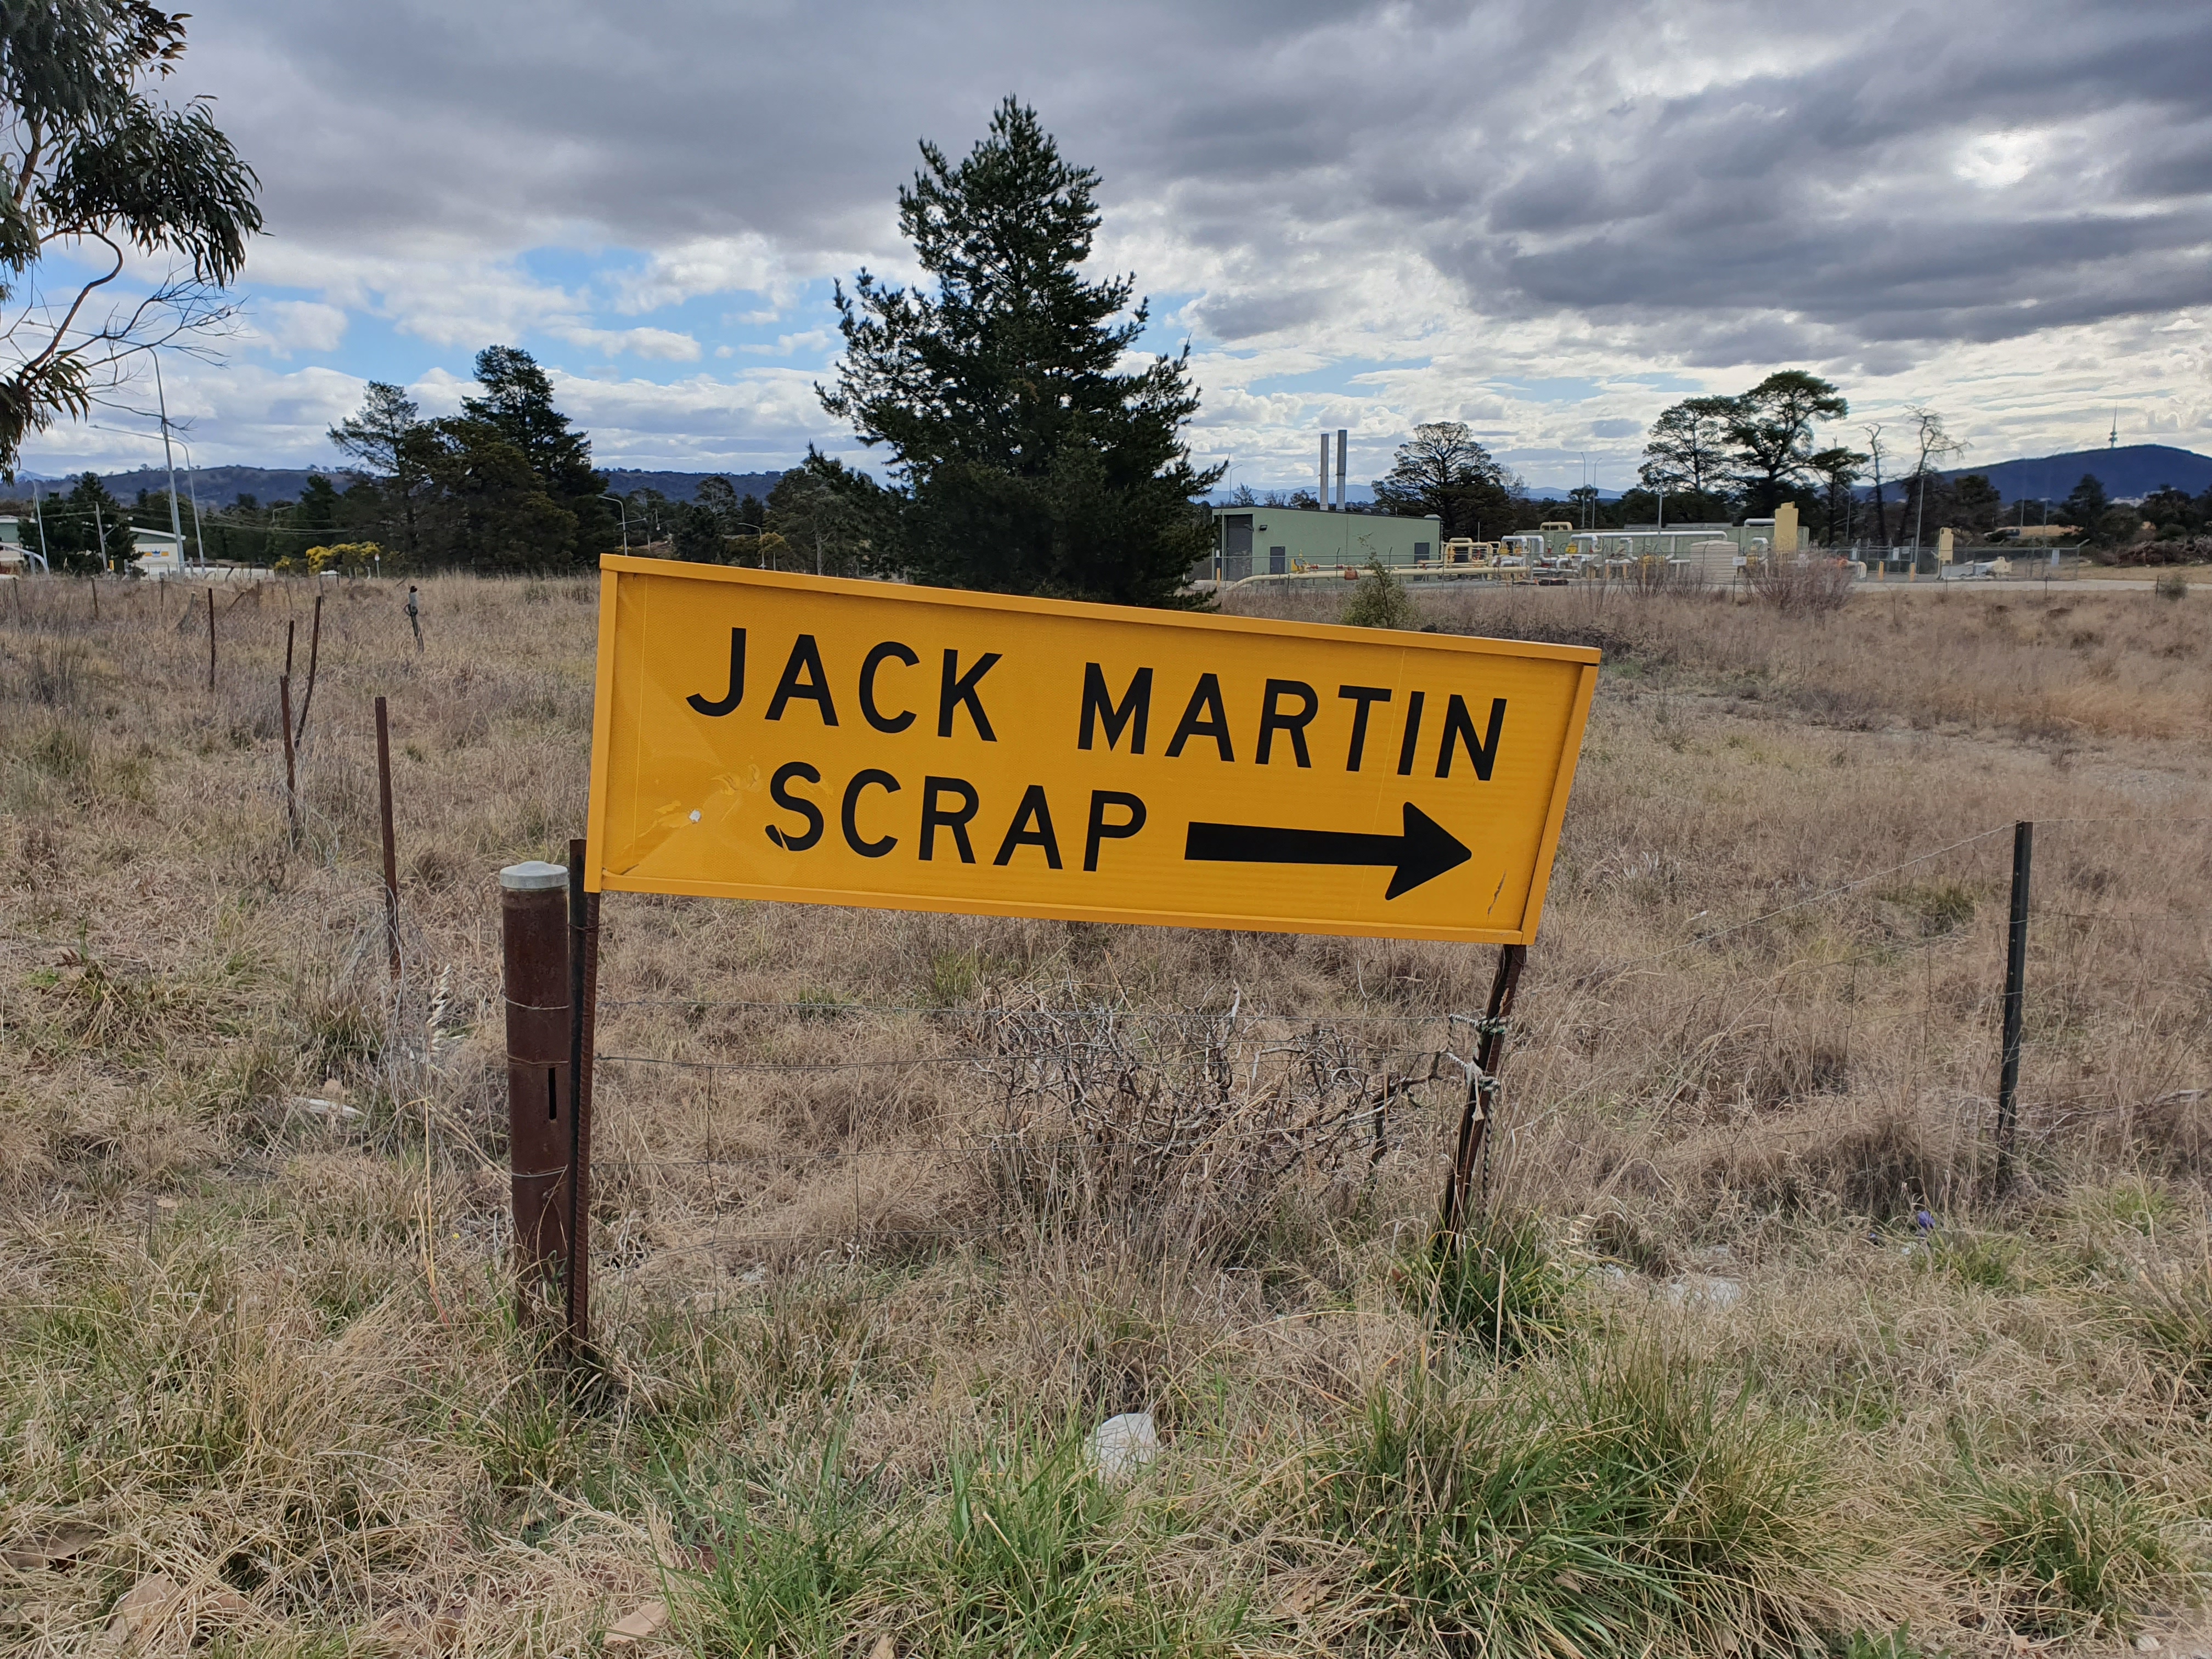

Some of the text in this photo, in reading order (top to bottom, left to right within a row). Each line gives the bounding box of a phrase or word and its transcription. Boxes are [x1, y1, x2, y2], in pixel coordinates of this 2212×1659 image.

[686, 627, 1508, 782] JACK MARTIN
[765, 761, 1147, 872] SCRAP
